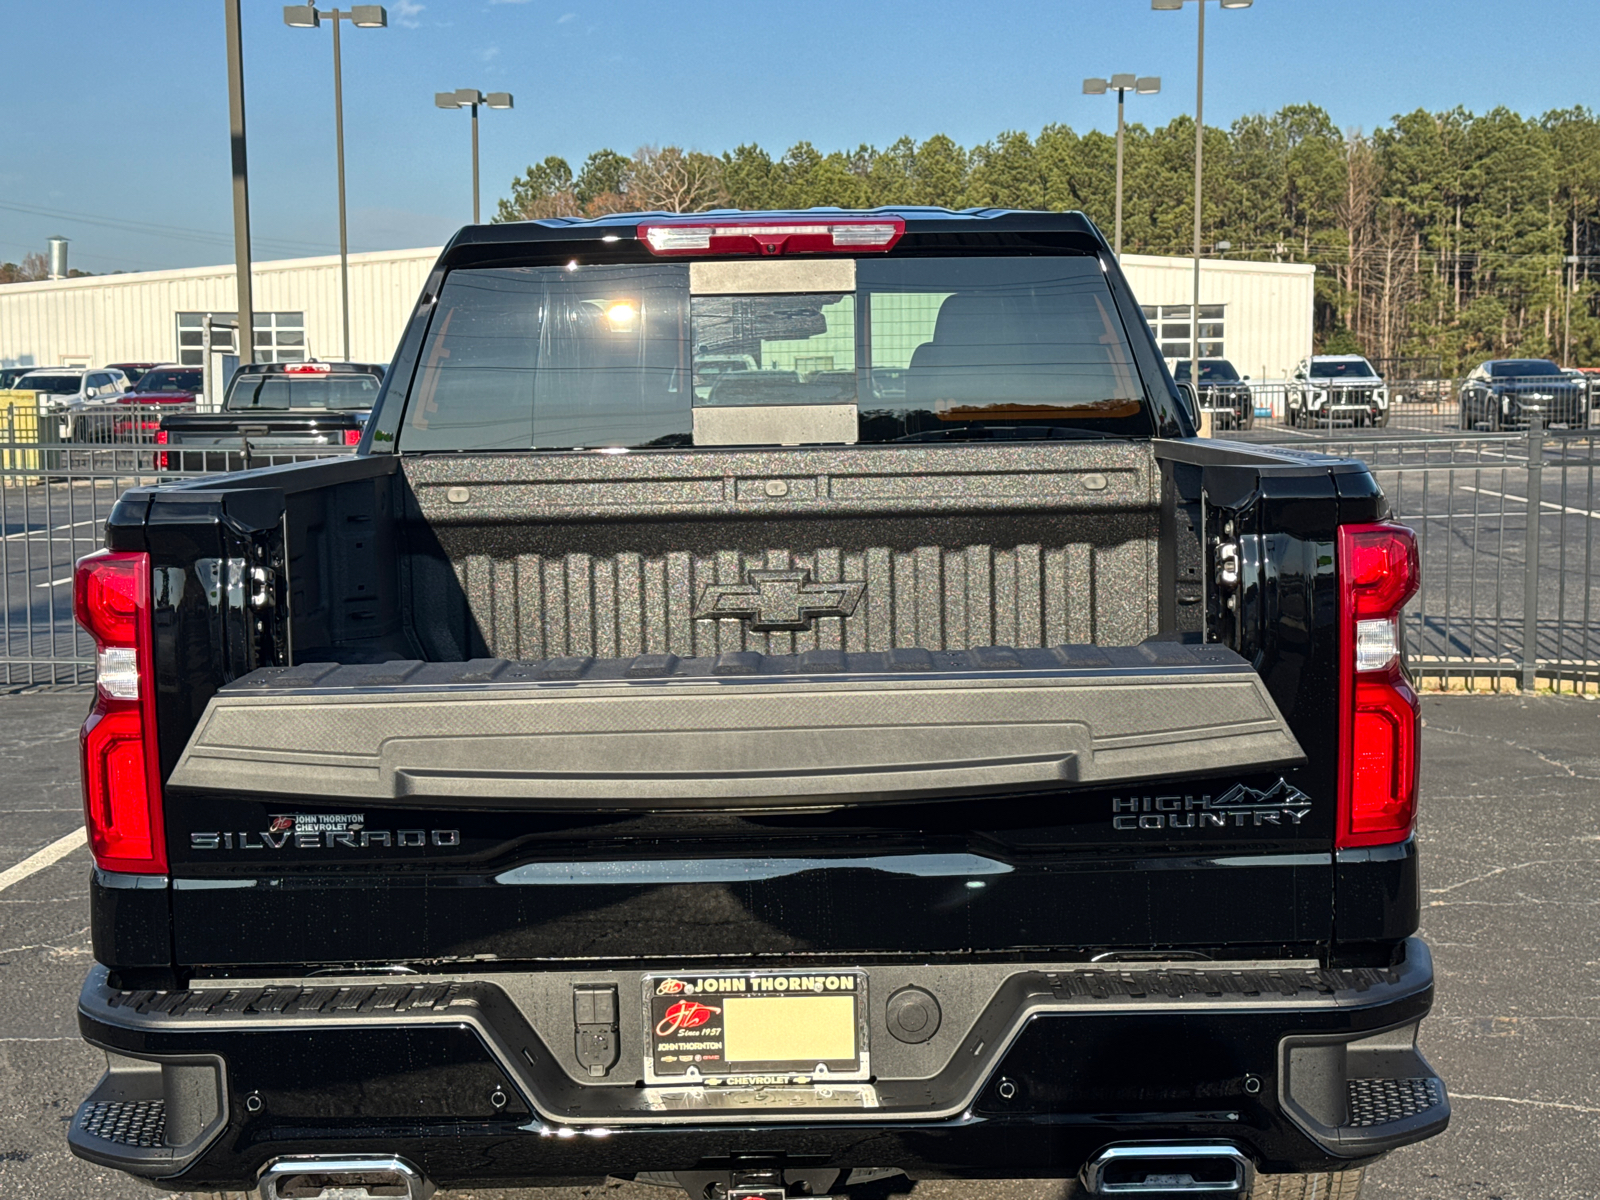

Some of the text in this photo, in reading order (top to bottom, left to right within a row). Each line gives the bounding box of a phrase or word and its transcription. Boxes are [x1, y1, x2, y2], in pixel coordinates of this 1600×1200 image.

[1112, 795, 1211, 812] HIGH
[295, 814, 364, 824] JOHN THORNTON
[1112, 808, 1312, 830] COUNTRY
[295, 823, 347, 831] CHEVROLET
[190, 829, 461, 850] SILVERADO
[694, 976, 854, 993] JOHN THORNTON
[677, 1027, 722, 1037] Since 1957
[657, 1041, 723, 1052] JOHN THORNTON
[726, 1076, 790, 1086] CHEVROLET
